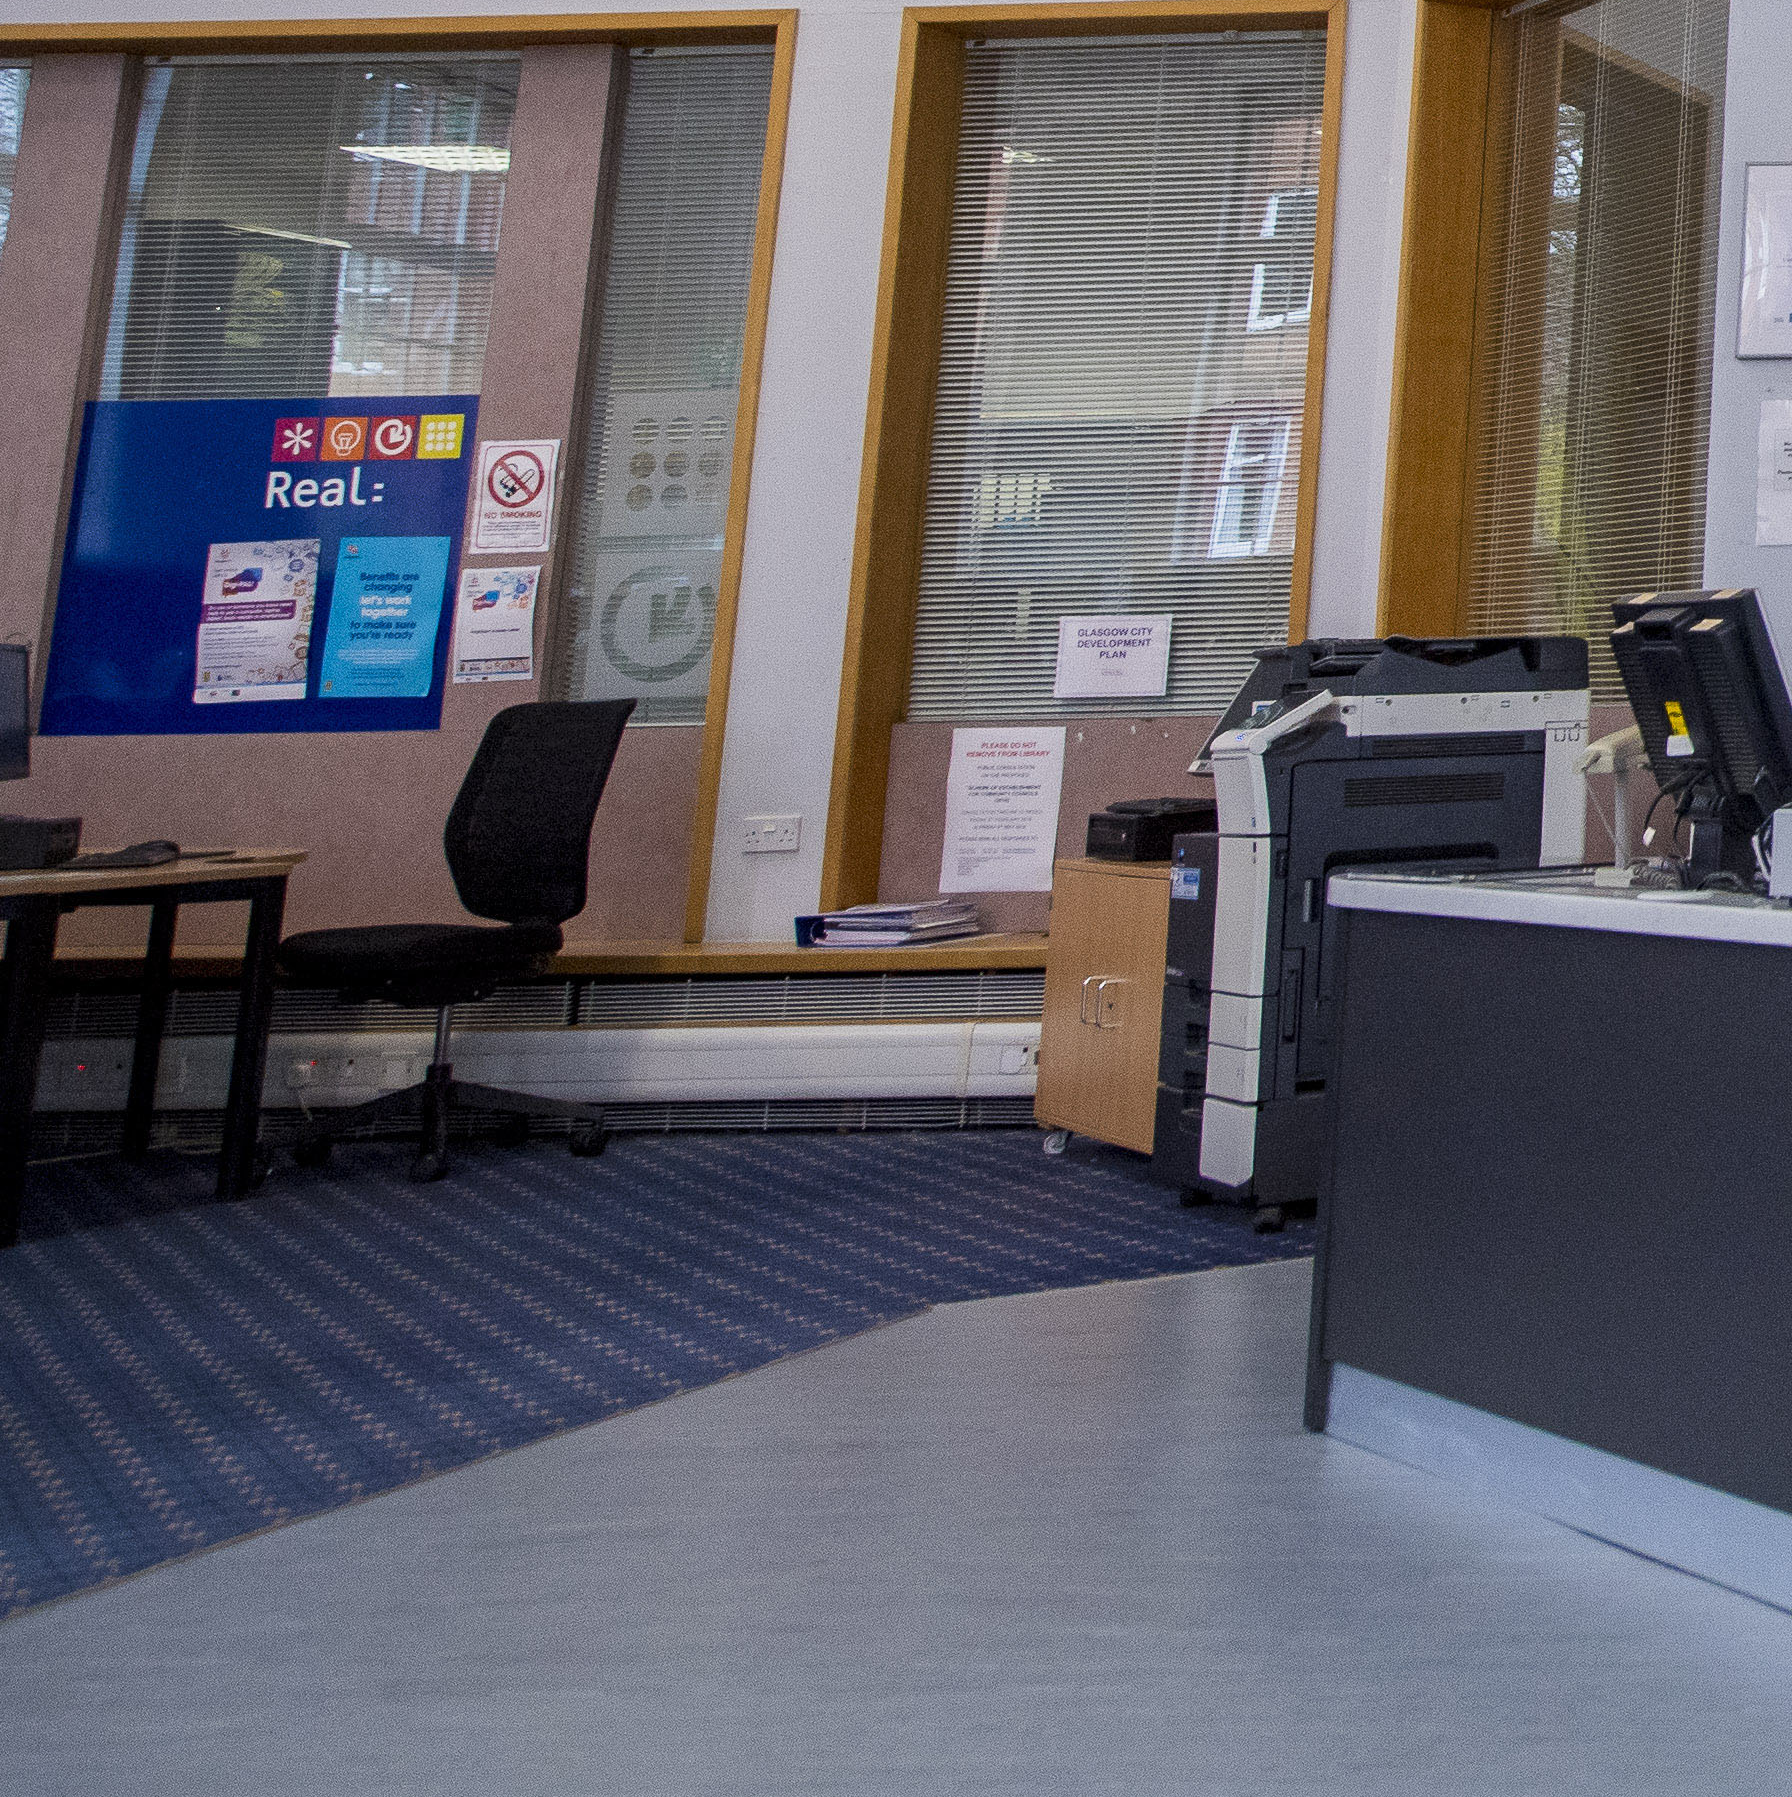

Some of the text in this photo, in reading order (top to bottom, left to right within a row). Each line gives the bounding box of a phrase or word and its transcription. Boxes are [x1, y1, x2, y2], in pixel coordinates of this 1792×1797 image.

[265, 466, 385, 509] Real:
[501, 510, 542, 519] SMOKING
[1077, 627, 1153, 638] GLASGOW CITY
[1077, 638, 1151, 649] DEVELOPMENT
[1099, 650, 1127, 660] PLAN
[1022, 741, 1038, 749] NOT
